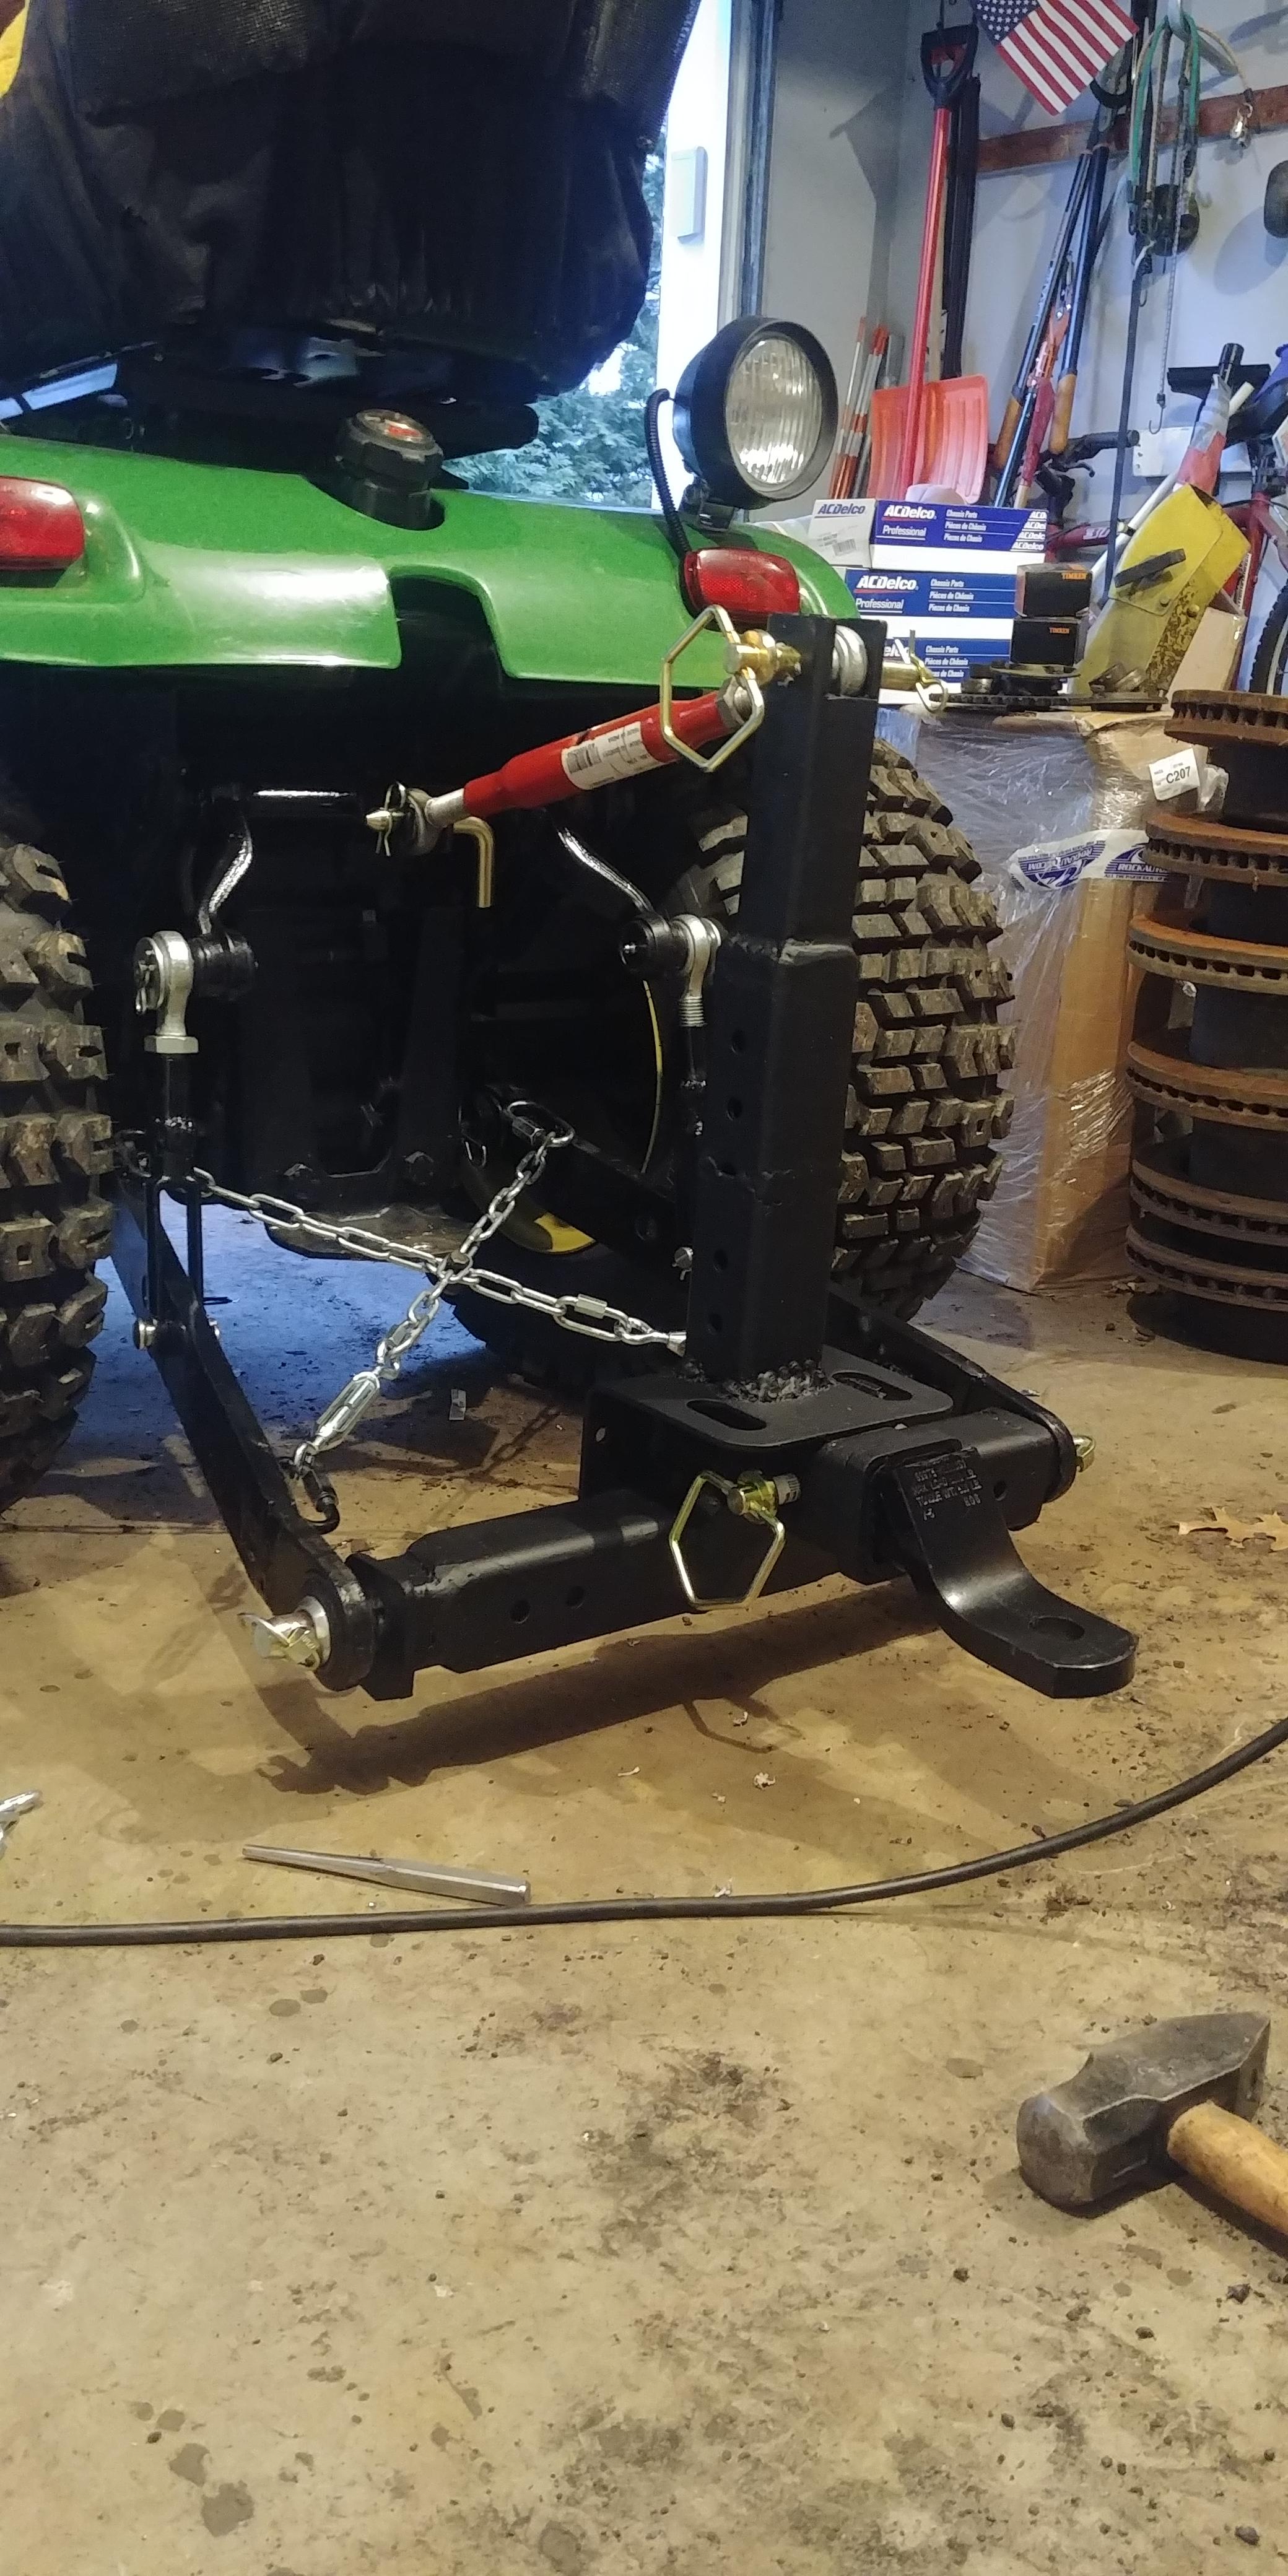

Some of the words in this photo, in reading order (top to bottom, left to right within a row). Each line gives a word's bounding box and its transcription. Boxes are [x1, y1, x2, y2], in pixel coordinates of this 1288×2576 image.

[817, 503, 866, 515] ACDelco
[884, 505, 936, 520] ACDelco
[965, 510, 978, 519] Parts
[882, 524, 927, 536] Professional
[962, 522, 968, 530] de
[960, 534, 966, 542] de
[856, 575, 917, 590] ACDelco
[951, 579, 964, 588] Parts
[947, 591, 954, 599] de
[856, 598, 904, 609] Professional
[946, 604, 952, 612] de
[946, 645, 959, 653] Parts
[942, 658, 949, 666] de
[1166, 766, 1191, 784] C207
